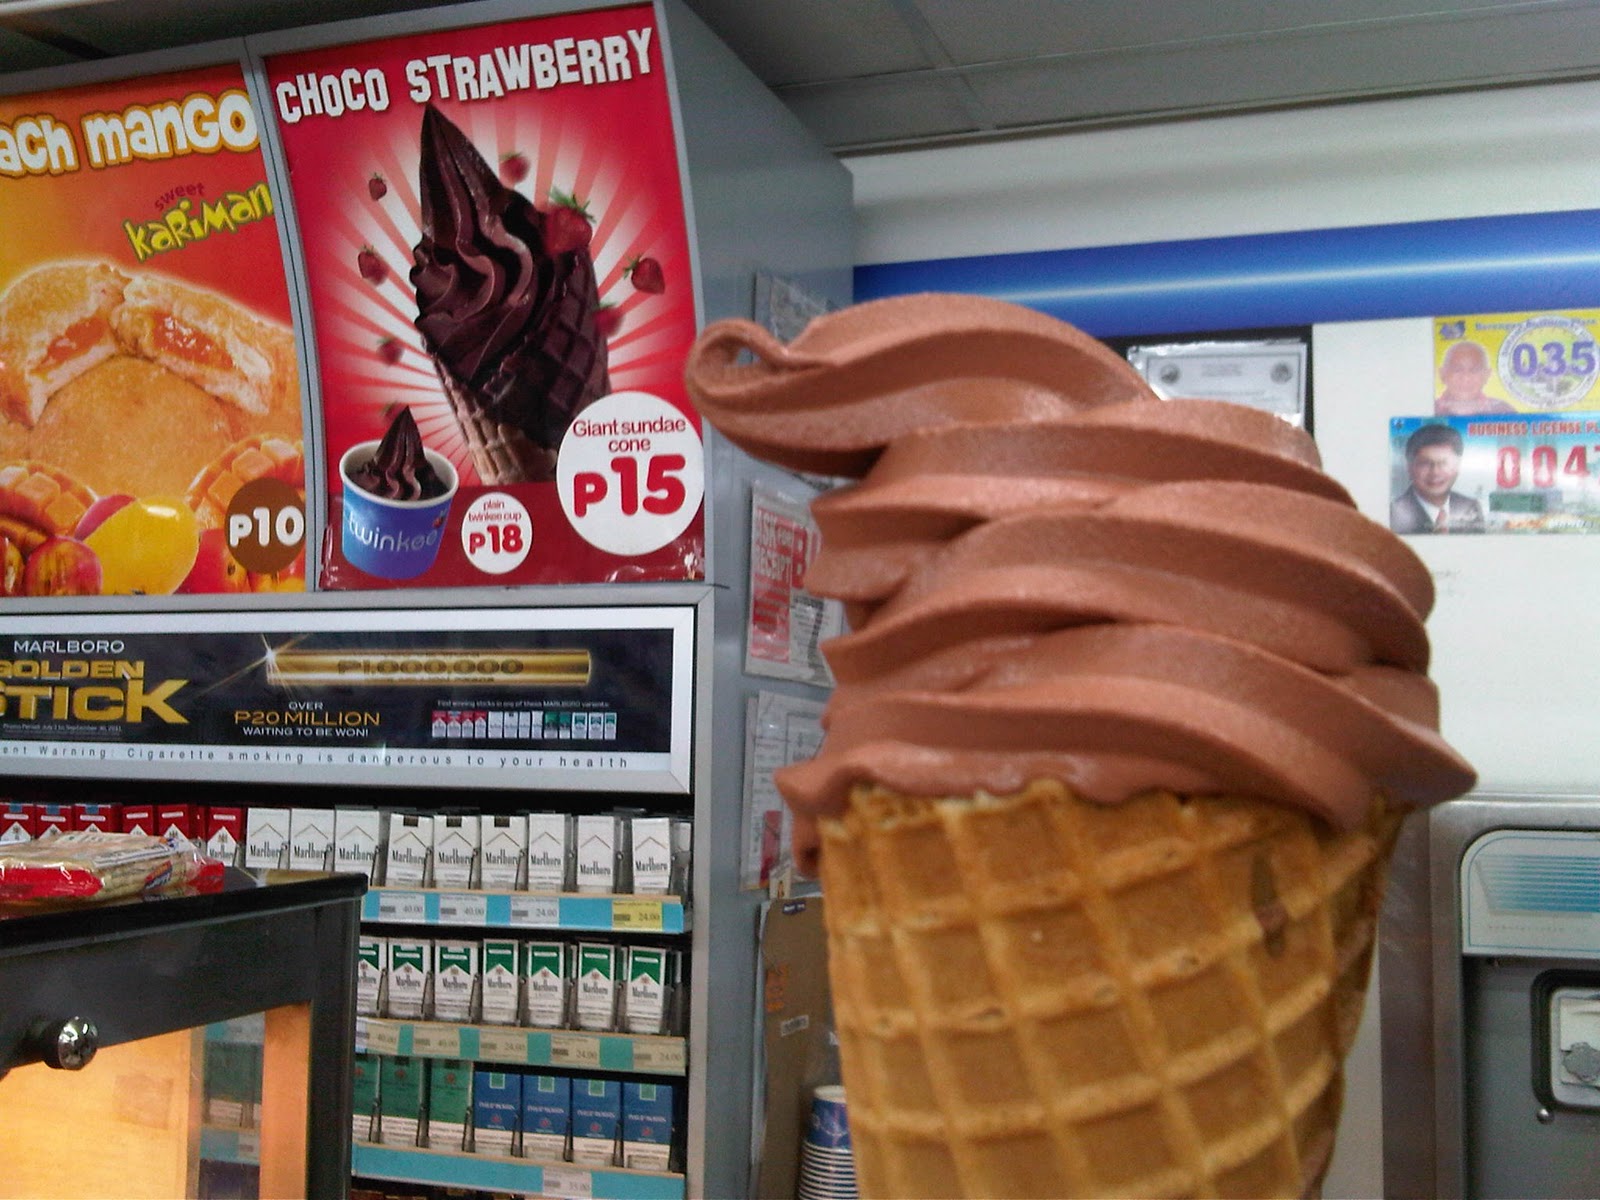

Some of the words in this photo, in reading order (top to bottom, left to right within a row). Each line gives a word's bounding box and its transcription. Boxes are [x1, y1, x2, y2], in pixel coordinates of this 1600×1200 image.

[275, 68, 390, 123] CHOCO
[405, 27, 652, 102] STRAWBERRY
[154, 182, 205, 212] sweet
[1512, 341, 1596, 378] 035
[572, 419, 619, 438] Giant
[620, 416, 687, 436] sundae
[1468, 421, 1528, 436] BUSINESS
[1531, 420, 1582, 435] LICENSE
[608, 437, 651, 453] cone
[1496, 445, 1600, 489] 004
[572, 454, 687, 518] P15
[483, 500, 505, 512] plain
[503, 513, 522, 523] cup
[228, 505, 302, 548] P10
[468, 523, 524, 555] P18
[13, 640, 125, 653] MARLBORO
[0, 679, 190, 725] TICK
[288, 701, 325, 711] OVER
[234, 710, 280, 726] P20
[284, 711, 381, 727] MILLION
[242, 726, 294, 737] WAITING
[296, 727, 313, 737] TO
[316, 727, 333, 737] BE
[335, 727, 369, 738] WON!
[127, 748, 215, 761] Cigarette
[228, 751, 304, 765] smoking
[318, 752, 333, 762] is
[347, 753, 453, 767] dangerous
[467, 754, 484, 766] to
[500, 756, 543, 768] your
[559, 756, 628, 768] health
[250, 841, 281, 857] Marlbor
[530, 851, 562, 866] Marlboro
[635, 857, 668, 872] Marlboro
[579, 860, 611, 875] Marlboro
